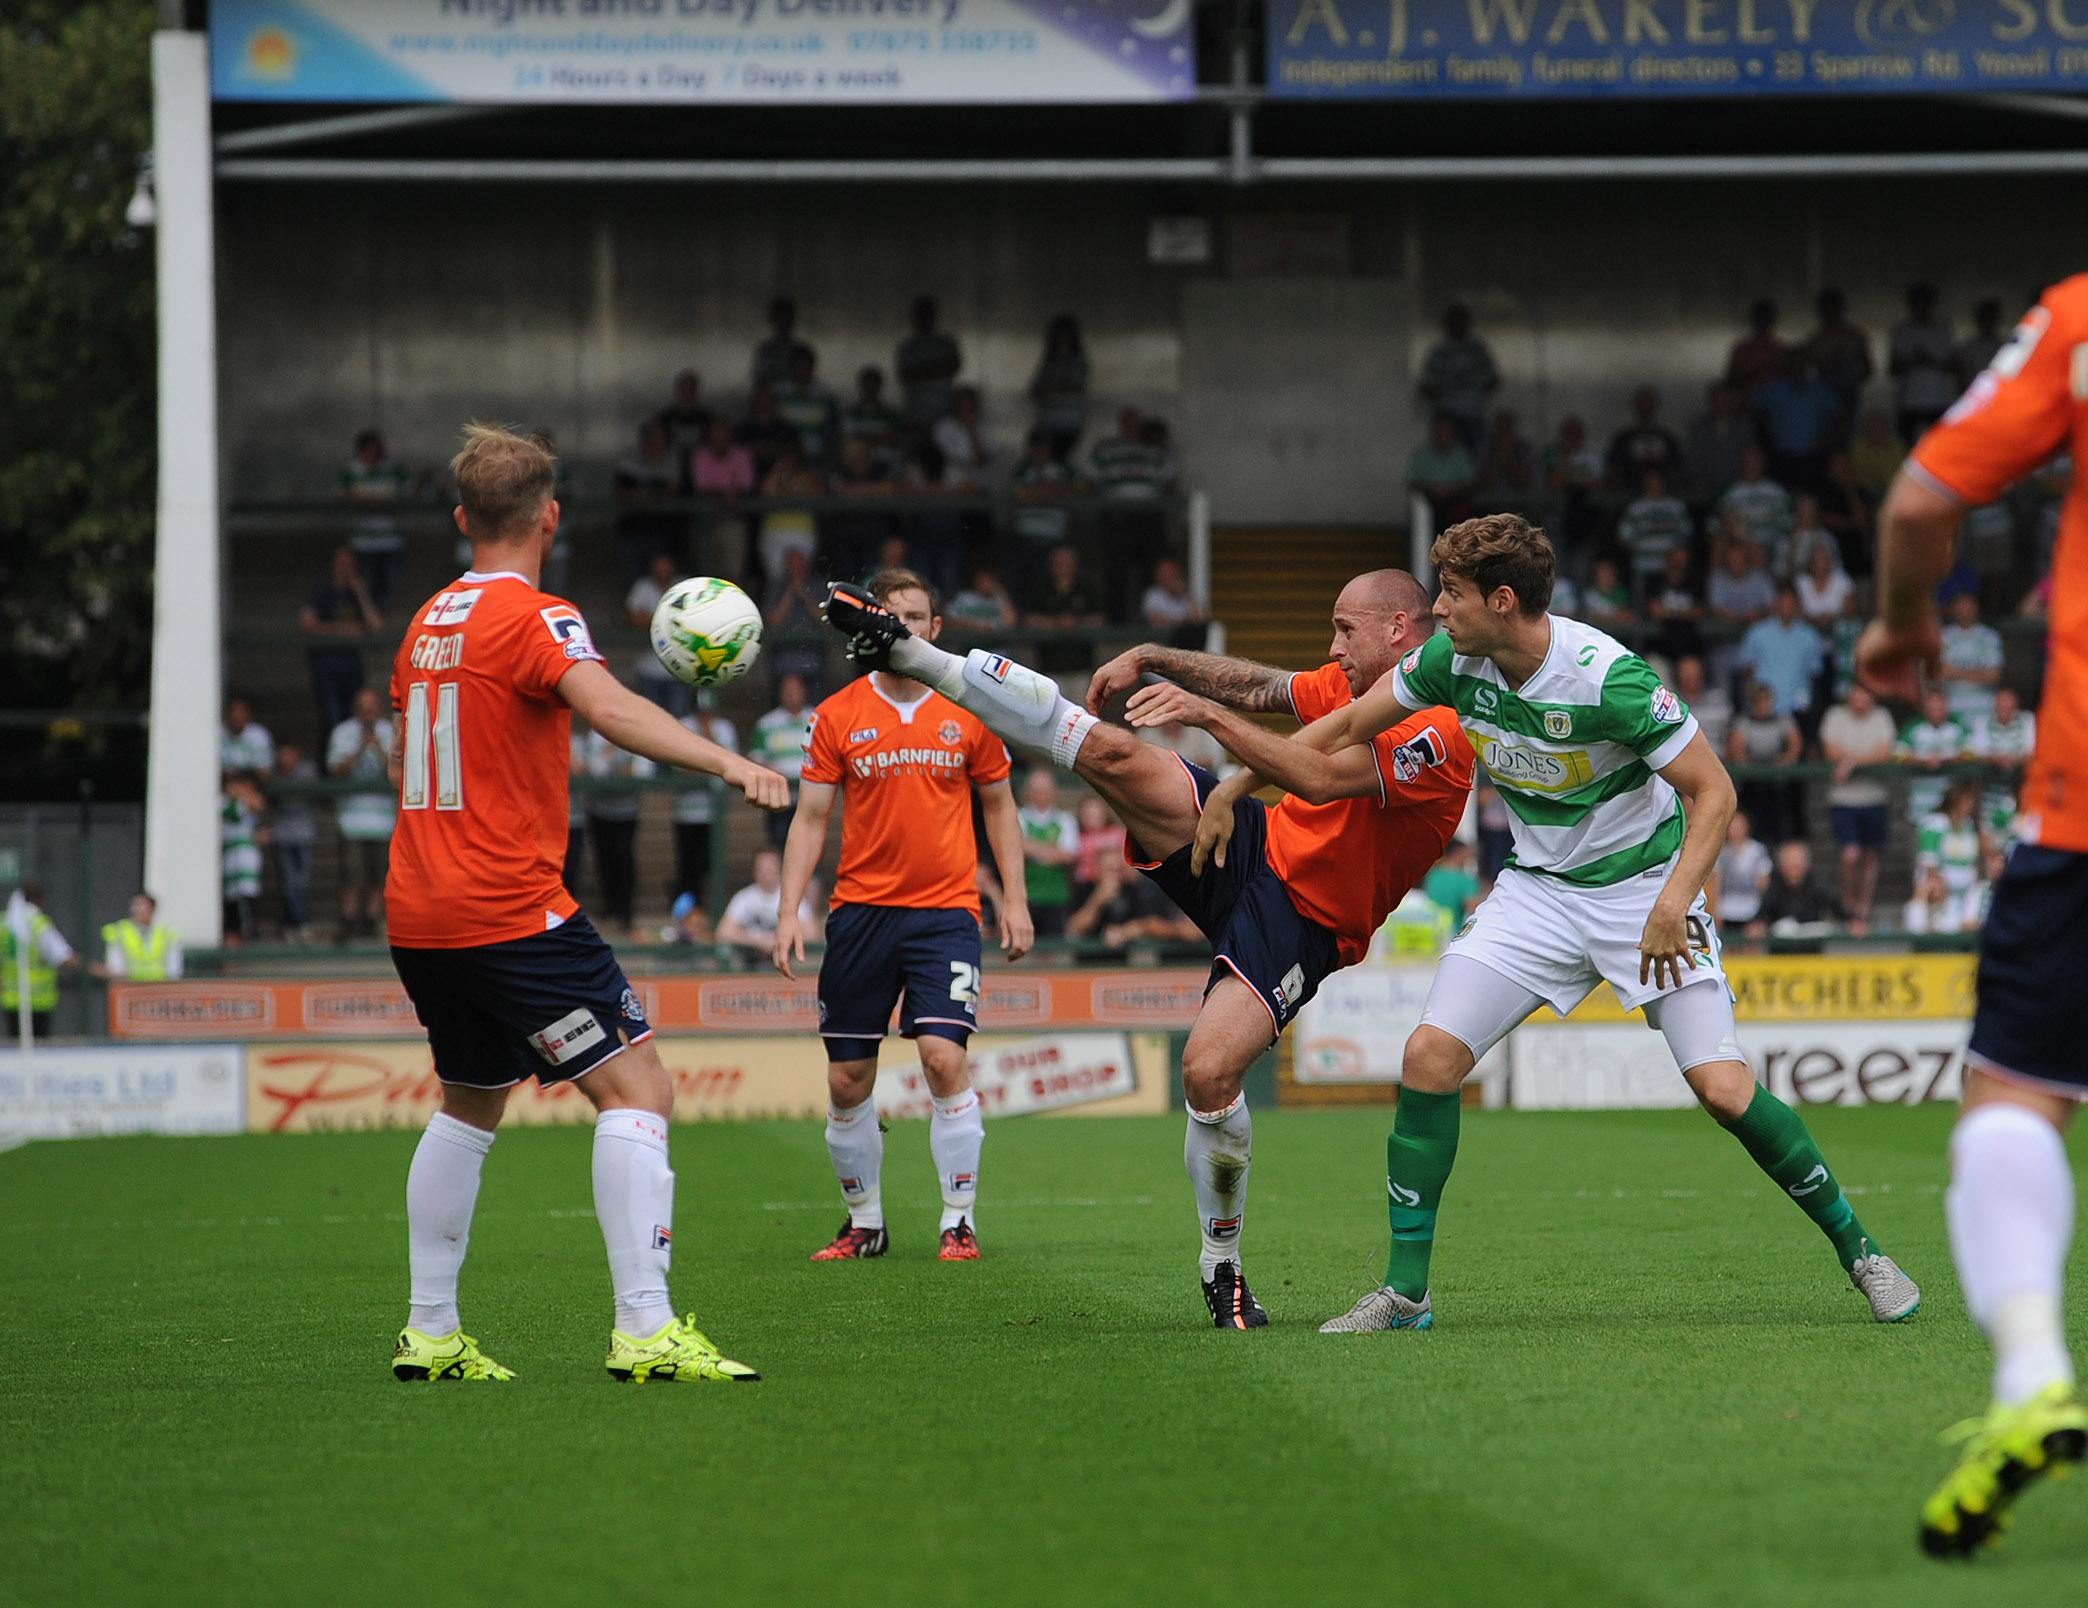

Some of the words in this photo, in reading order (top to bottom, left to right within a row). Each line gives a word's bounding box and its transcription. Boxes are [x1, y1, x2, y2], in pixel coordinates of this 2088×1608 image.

[1466, 0, 1822, 46] WAKELY
[551, 65, 628, 88] Hours
[656, 63, 706, 90] Day
[743, 62, 803, 89] Days
[836, 63, 902, 87] week
[1447, 52, 1523, 88] family
[1532, 51, 1624, 83] funeral
[1630, 53, 1740, 83] directors
[410, 632, 465, 671] GREEN
[402, 682, 464, 811] 11
[876, 748, 965, 768] BARNFIELD
[1487, 743, 1561, 776] JONES
[1737, 966, 1924, 1008] ATCHERS
[1031, 1064, 1117, 1097] SHOP
[1764, 1049, 1966, 1104] reez
